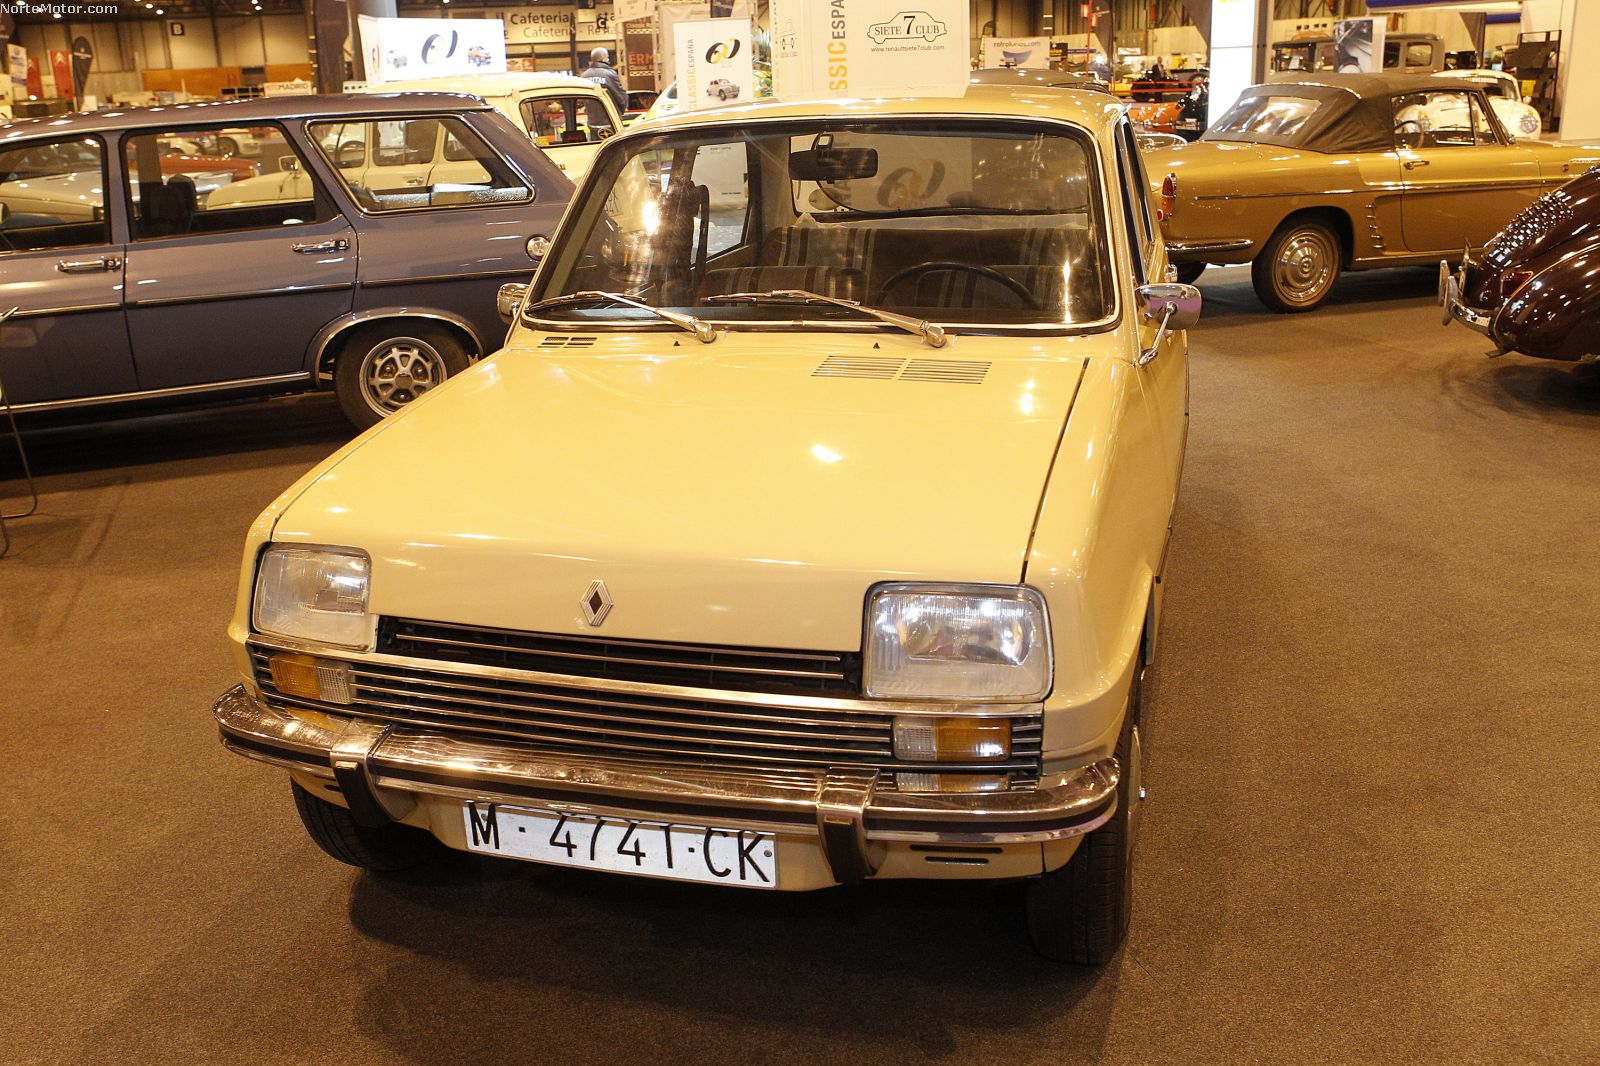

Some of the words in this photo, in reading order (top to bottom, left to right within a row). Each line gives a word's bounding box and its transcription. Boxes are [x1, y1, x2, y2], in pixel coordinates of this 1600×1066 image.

[172, 24, 183, 35] B
[874, 26, 902, 36] SIETE
[903, 15, 916, 35] 7
[915, 25, 940, 34] CLUB
[523, 26, 572, 39] Cafeteri
